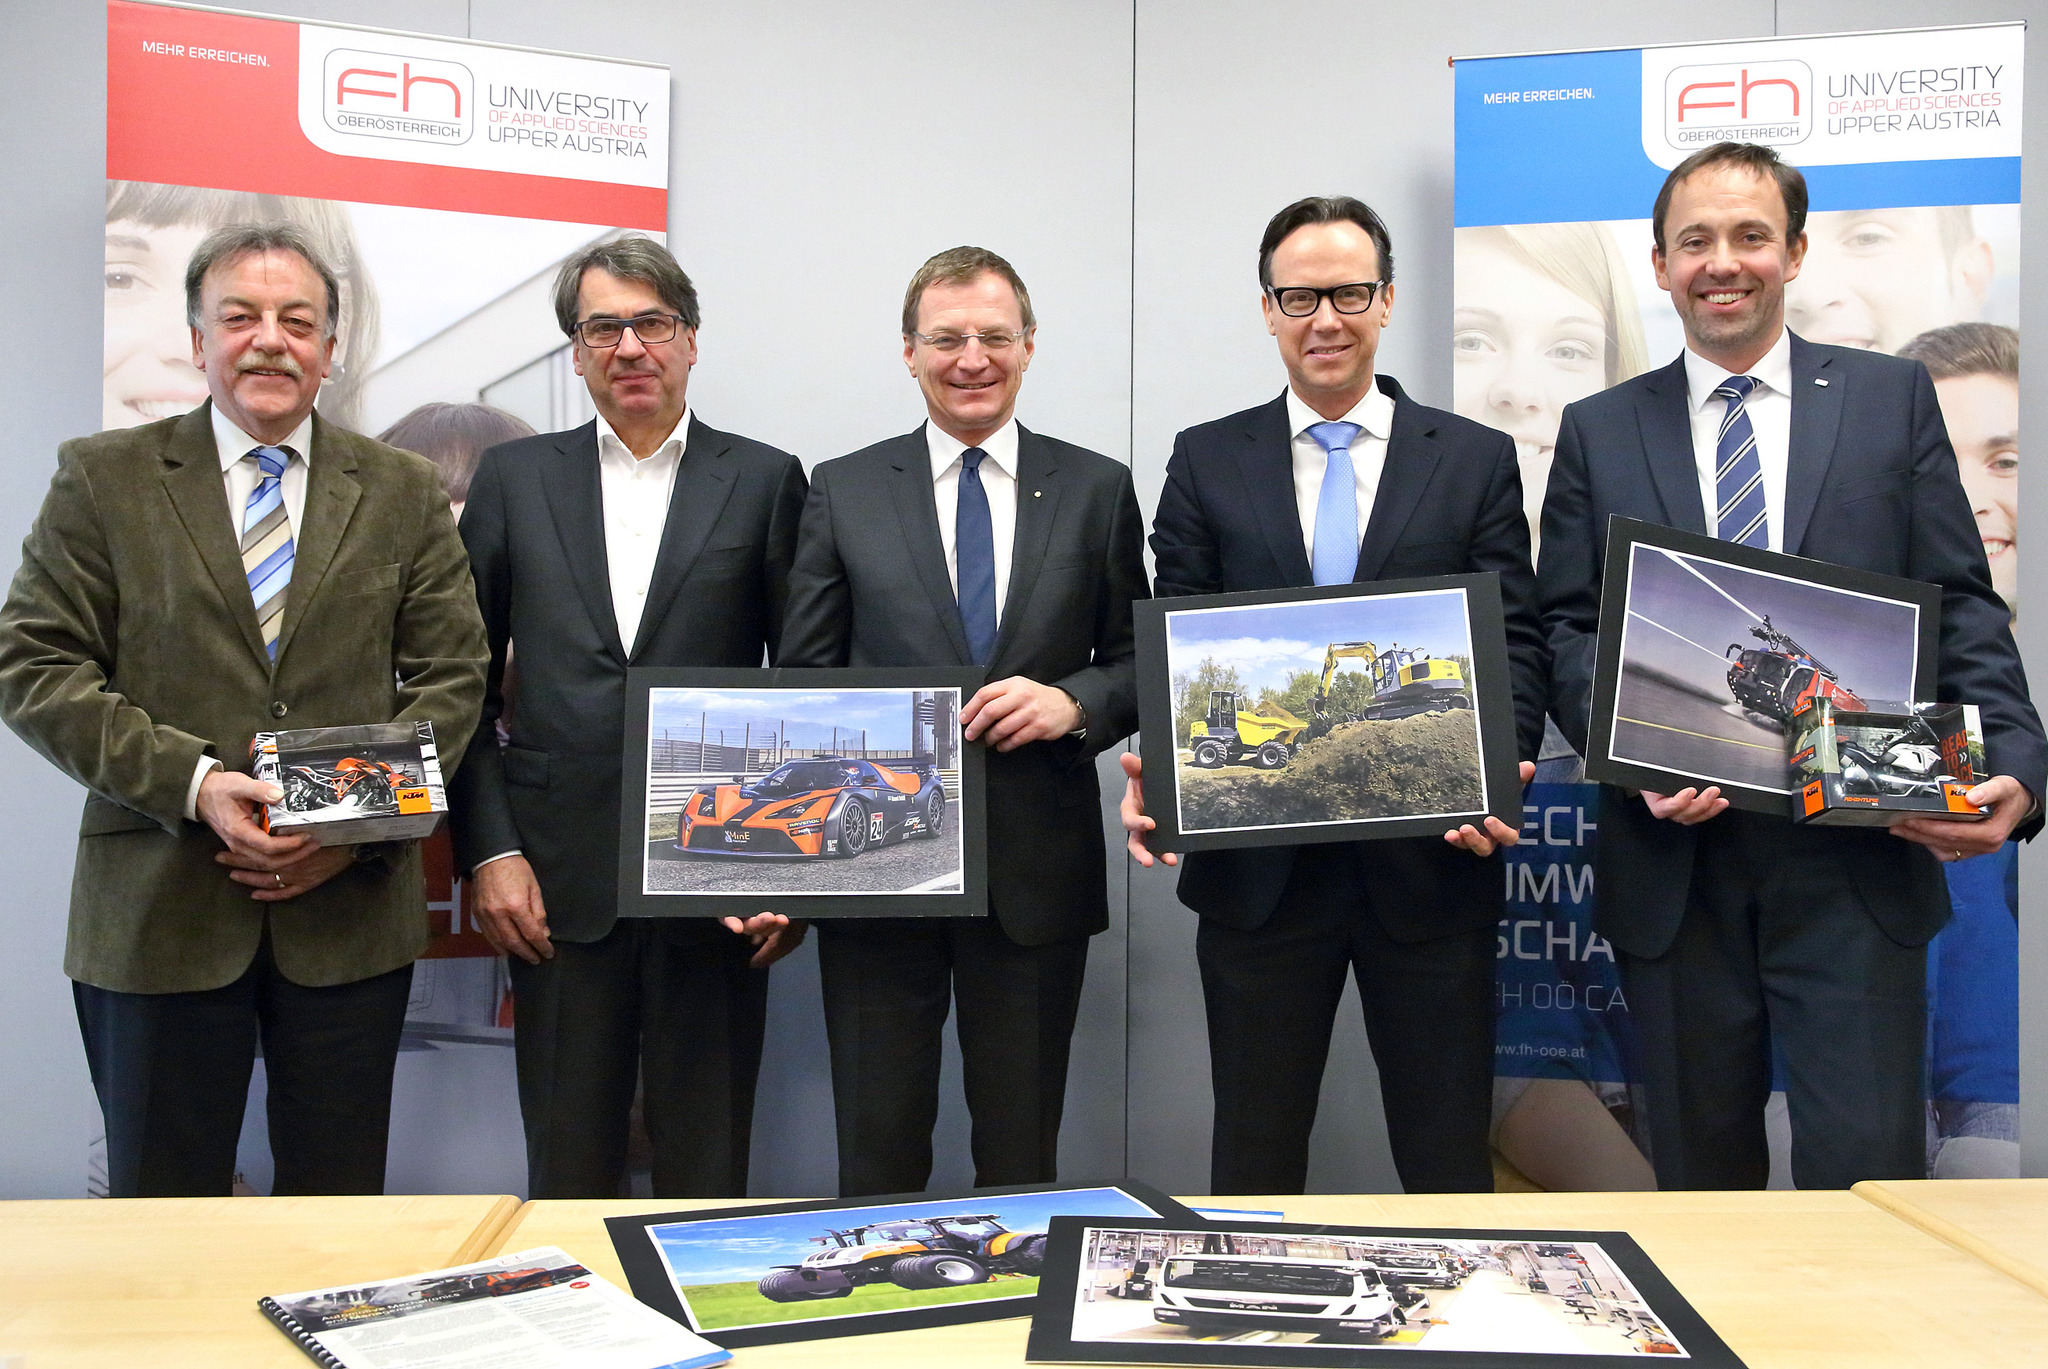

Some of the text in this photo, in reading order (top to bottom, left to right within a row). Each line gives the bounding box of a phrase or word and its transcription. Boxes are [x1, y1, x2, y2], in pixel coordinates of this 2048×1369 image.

[142, 40, 271, 68] MEHR ERREICHEN.
[1828, 64, 2003, 99] UNIVERSITY
[489, 83, 649, 123] UNIVERSITY
[1483, 87, 1596, 105] MEHR ERREICHEN.
[1828, 91, 2002, 115] OF APPLIED SCIENCES
[337, 114, 461, 138] OBERÖSTERREICH
[488, 109, 648, 140] OF APPLIED SCIENCES
[1678, 126, 1800, 142] OBERÖSTERREICH
[1828, 108, 2002, 136] UPPER AUSTRIA
[488, 124, 648, 159] UPPER AUSTRIA
[402, 791, 424, 800] KTM
[870, 820, 882, 839] 24
[1532, 980, 1575, 1010] OÖ
[1585, 985, 1629, 1013] CA
